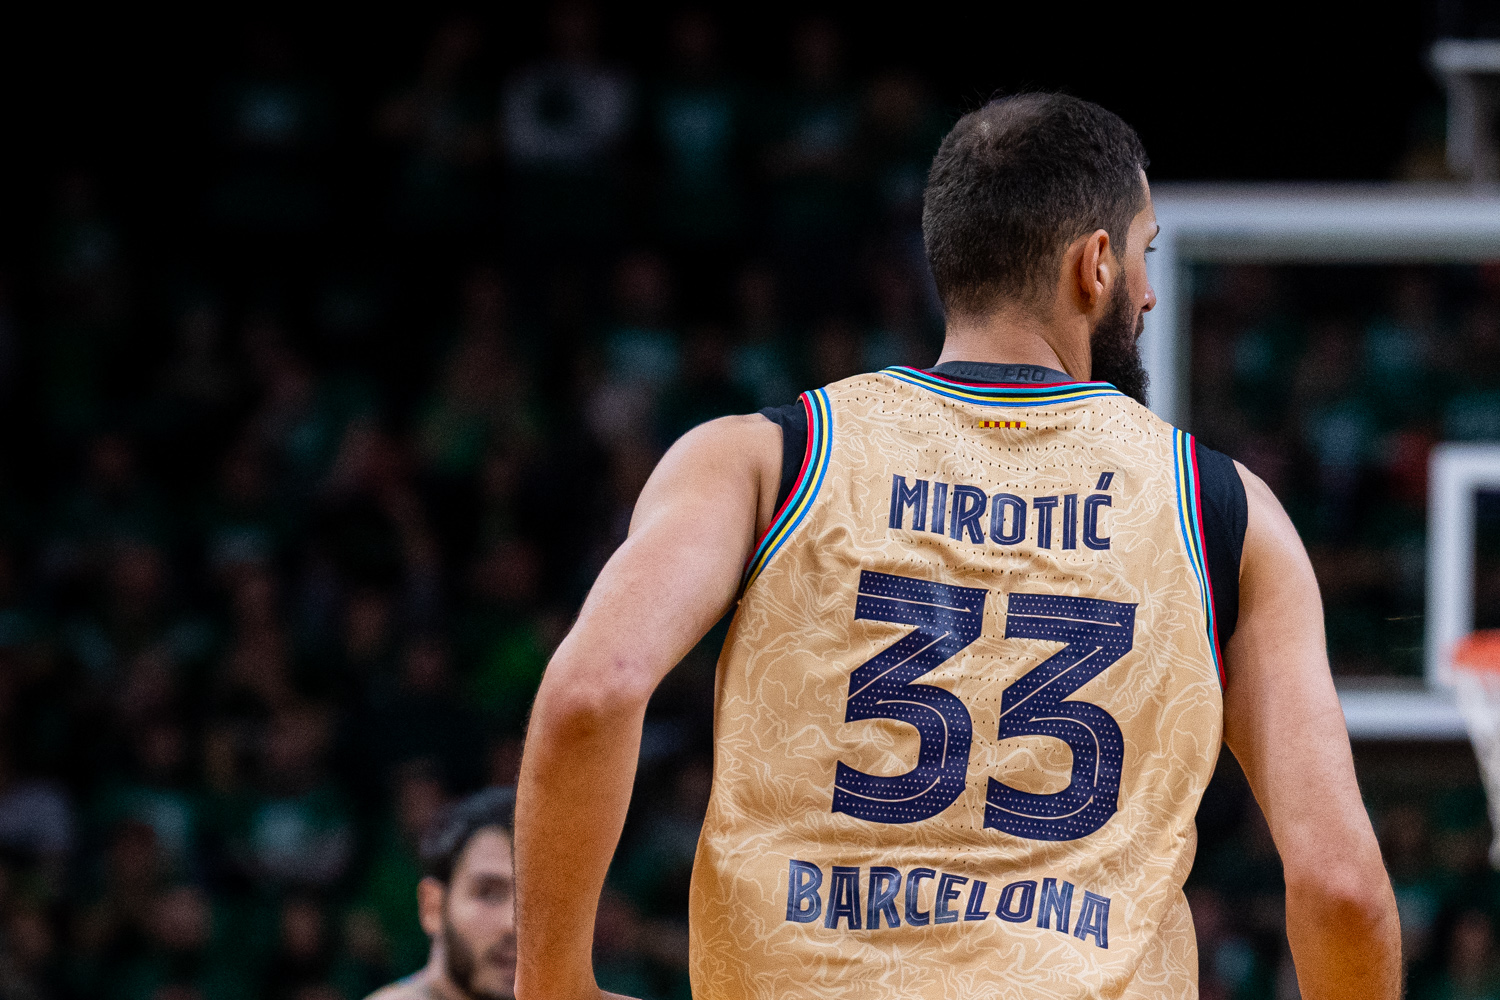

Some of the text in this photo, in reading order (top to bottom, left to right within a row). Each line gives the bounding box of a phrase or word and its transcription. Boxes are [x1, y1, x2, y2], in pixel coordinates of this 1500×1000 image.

[1002, 368, 1046, 381] PRO
[888, 472, 1113, 551] MIROTIĆ
[831, 569, 1140, 842] 33
[785, 859, 1111, 950] BARCELONA
